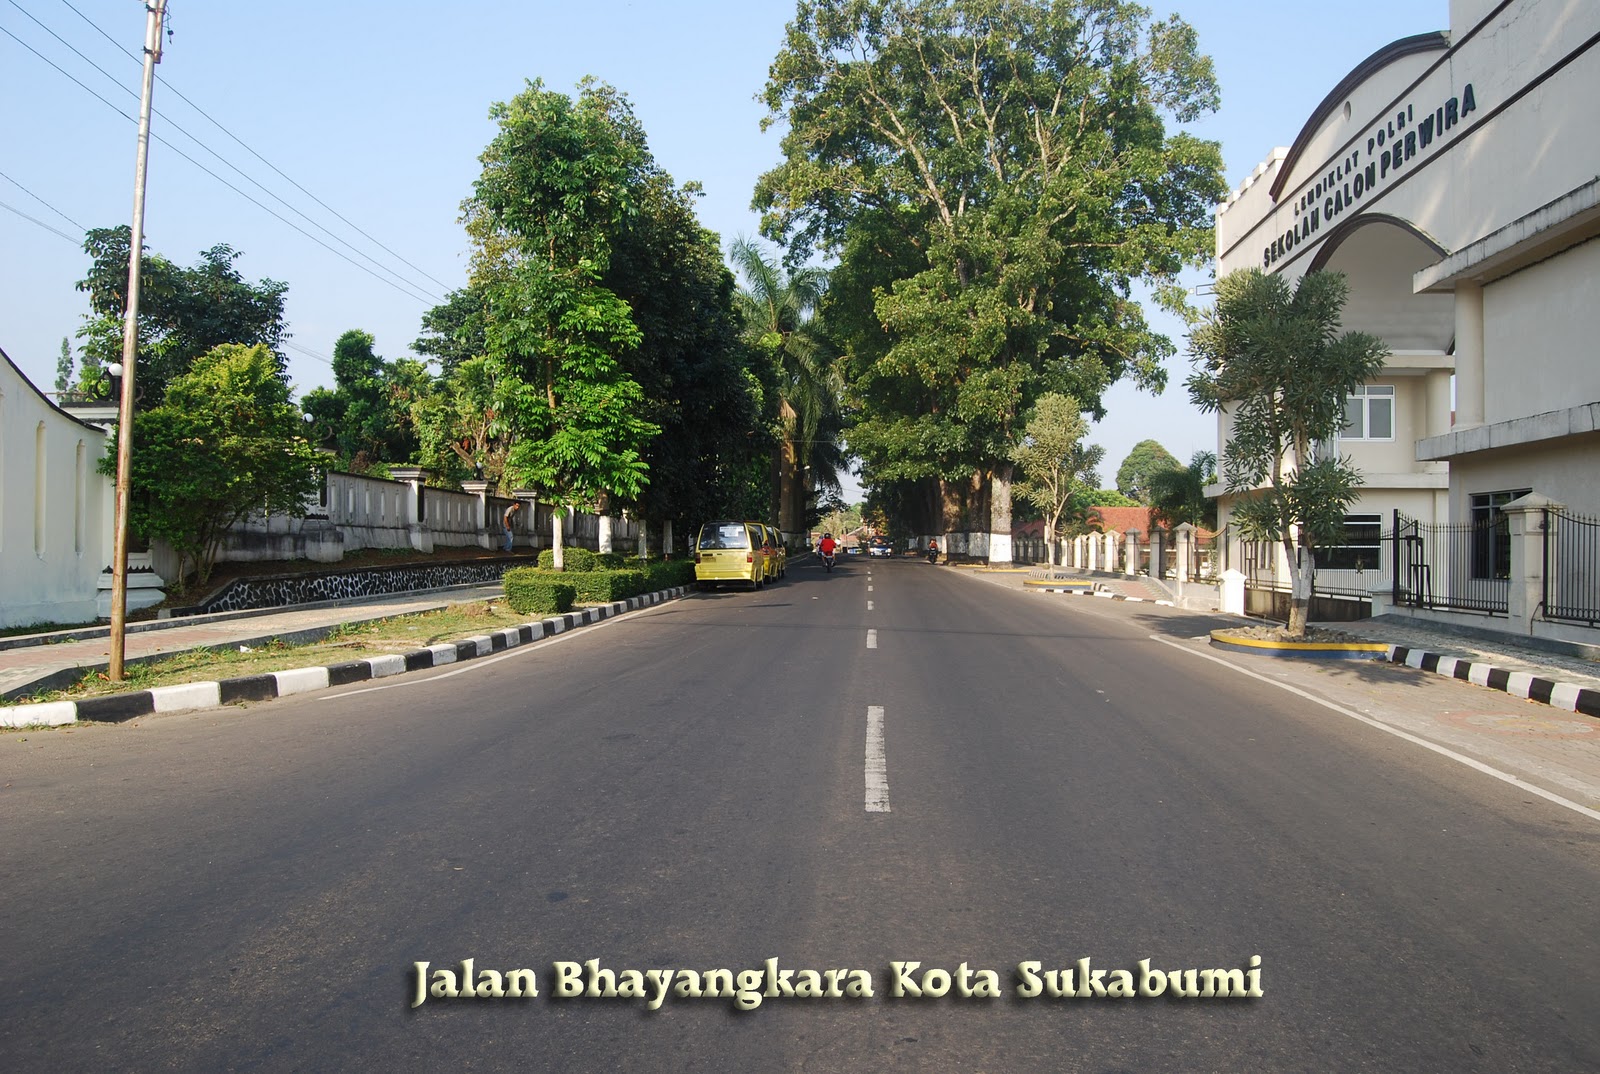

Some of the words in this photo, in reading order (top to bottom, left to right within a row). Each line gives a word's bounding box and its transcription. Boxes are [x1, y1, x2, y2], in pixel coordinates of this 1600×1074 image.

[1263, 206, 1320, 268] SEKOLAH
[1323, 161, 1376, 221] CALON
[1380, 83, 1476, 179] PERWIRA
[1367, 104, 1413, 156] POLRI
